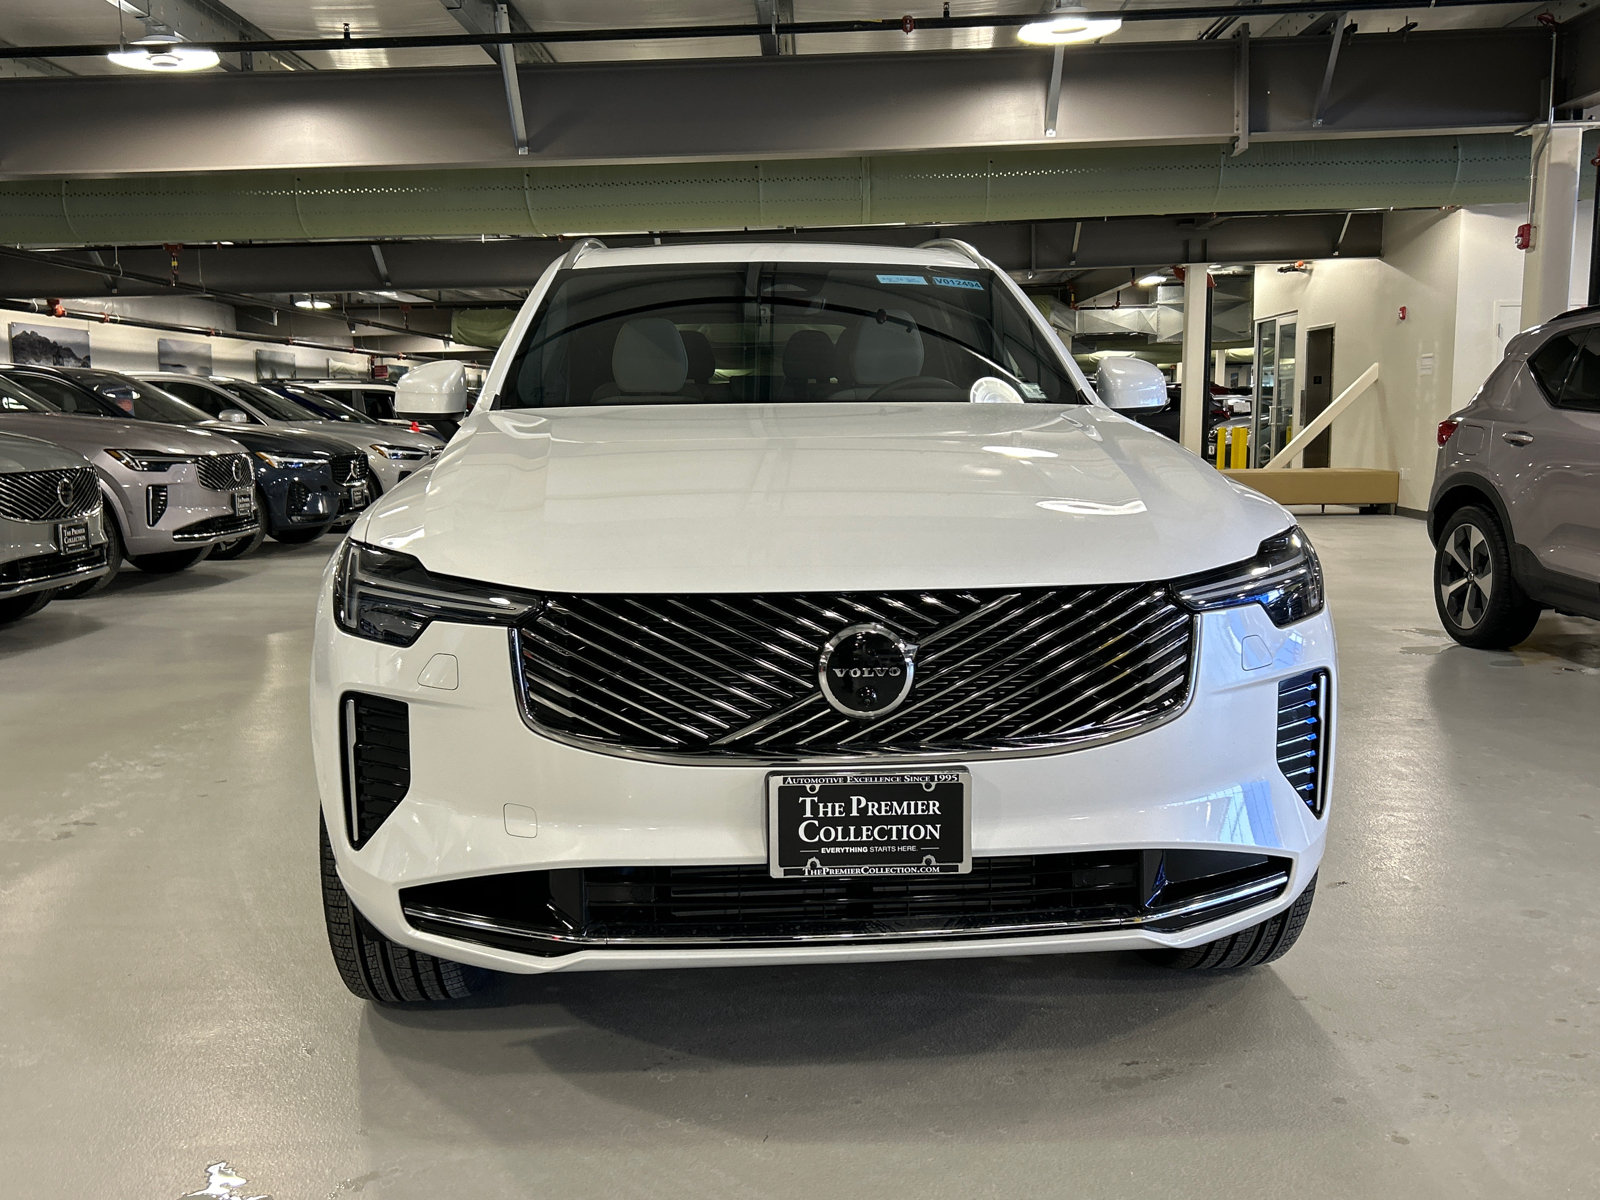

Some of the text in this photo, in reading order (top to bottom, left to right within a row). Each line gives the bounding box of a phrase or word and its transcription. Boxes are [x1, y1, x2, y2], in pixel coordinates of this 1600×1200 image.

[832, 666, 901, 678] VOLVO
[933, 774, 958, 782] 1995
[821, 846, 868, 854] EVERYTHING
